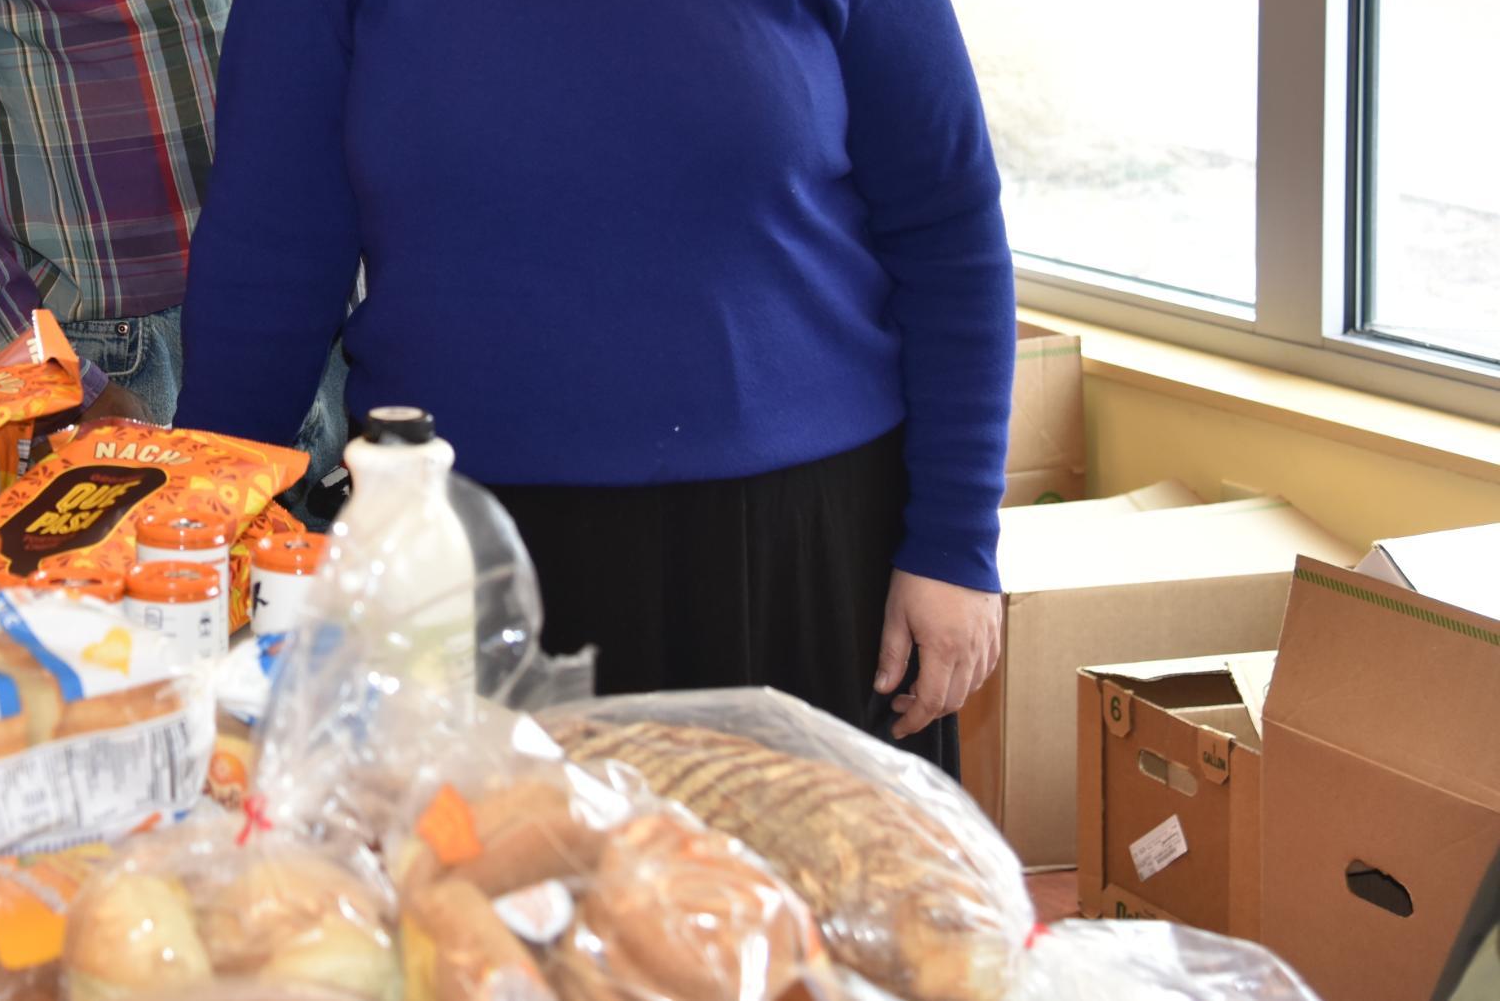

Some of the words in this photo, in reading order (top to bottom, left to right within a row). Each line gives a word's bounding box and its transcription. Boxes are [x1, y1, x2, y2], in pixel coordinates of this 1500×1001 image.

[55, 479, 142, 514] QUE
[25, 509, 104, 536] PASA
[1110, 695, 1122, 722] 6
[1203, 751, 1226, 772] GALLON
